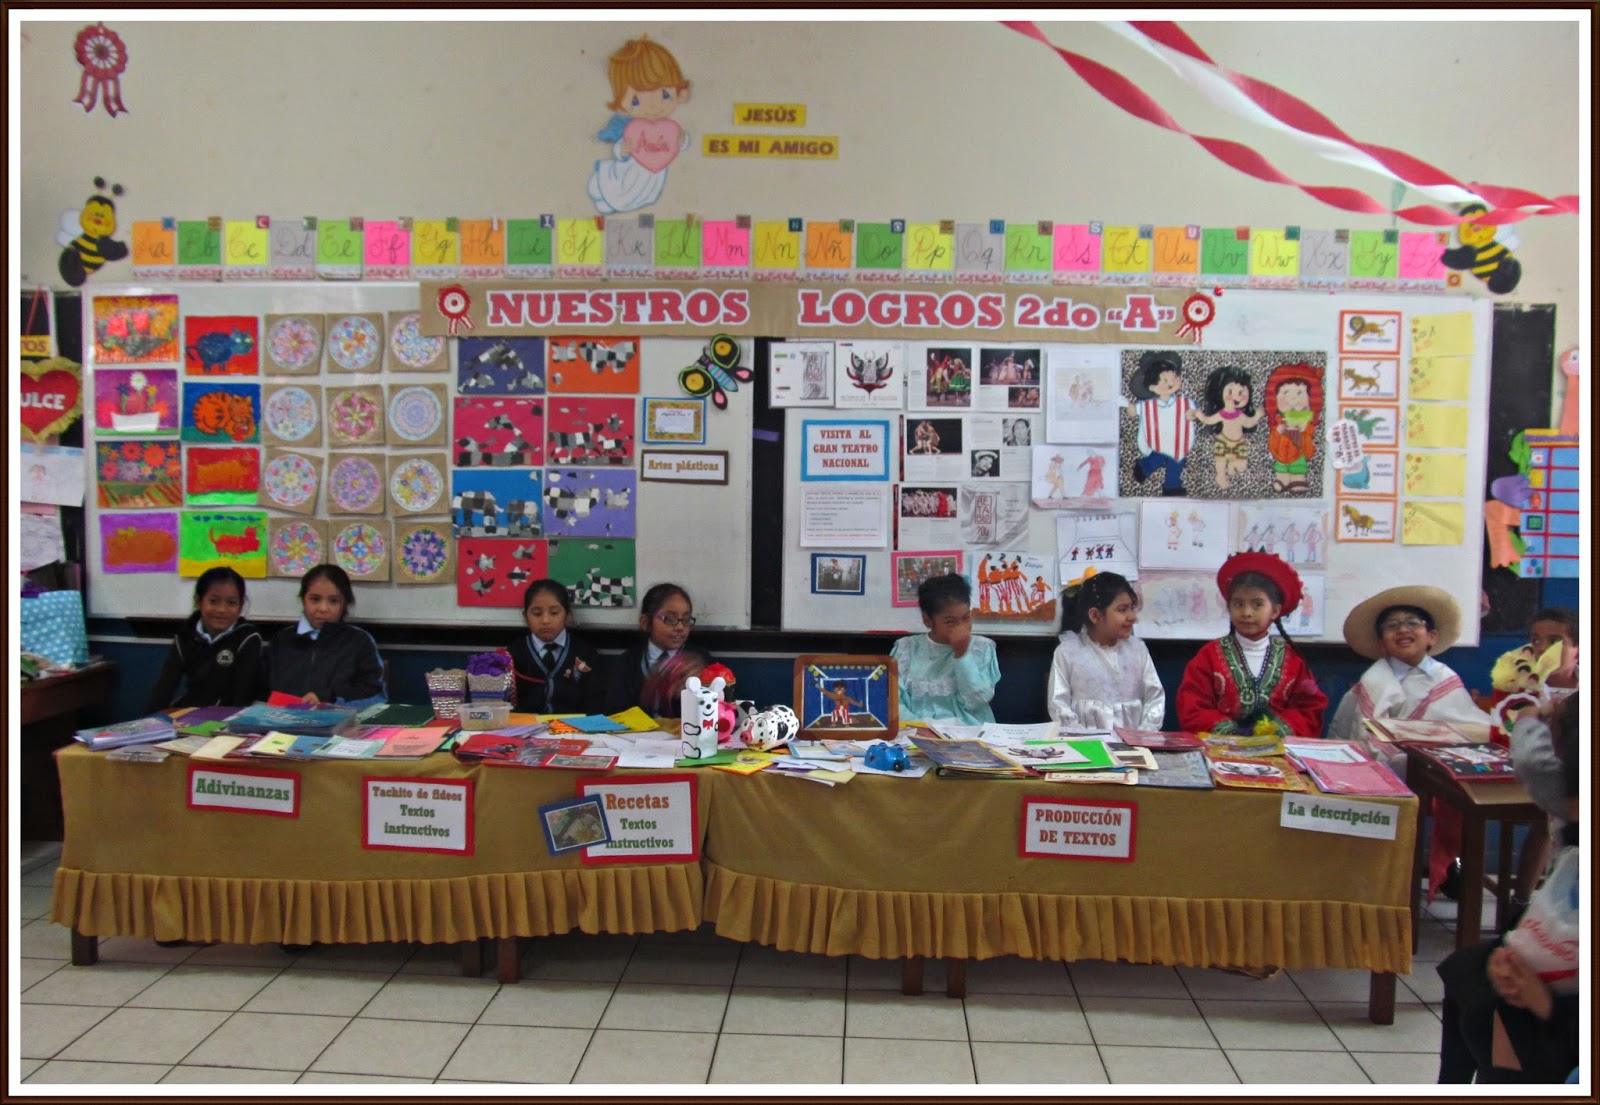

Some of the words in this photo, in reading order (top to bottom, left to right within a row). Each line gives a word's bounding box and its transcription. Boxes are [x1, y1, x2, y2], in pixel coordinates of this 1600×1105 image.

[743, 106, 797, 122] JESÚS
[709, 139, 729, 153] ES
[739, 140, 760, 153] MI
[769, 140, 834, 156] AMIGO
[488, 291, 749, 325] NUESTROS
[800, 290, 1004, 328] LOGROS
[1016, 297, 1098, 328] 2do
[820, 430, 852, 439] VISITA
[859, 430, 872, 439] AL
[813, 444, 838, 453] GRAN
[842, 444, 878, 453] TEATRO
[648, 460, 672, 470] Artes
[676, 460, 719, 473] plásticas
[822, 459, 869, 467] NACIONAL
[195, 778, 290, 801] Adivinanzas
[372, 786, 412, 798] Tachito
[417, 788, 428, 799] de
[432, 789, 462, 801] fideos
[605, 793, 670, 810] Recetas
[400, 804, 435, 818] Textos
[1035, 808, 1122, 826] PRODUCCIÓN
[1288, 802, 1305, 816] La
[1311, 804, 1390, 825] descripción
[384, 822, 450, 837] instructivos
[620, 818, 657, 830] Textos
[1039, 830, 1058, 843] DE
[1063, 831, 1116, 846] TEXTOS
